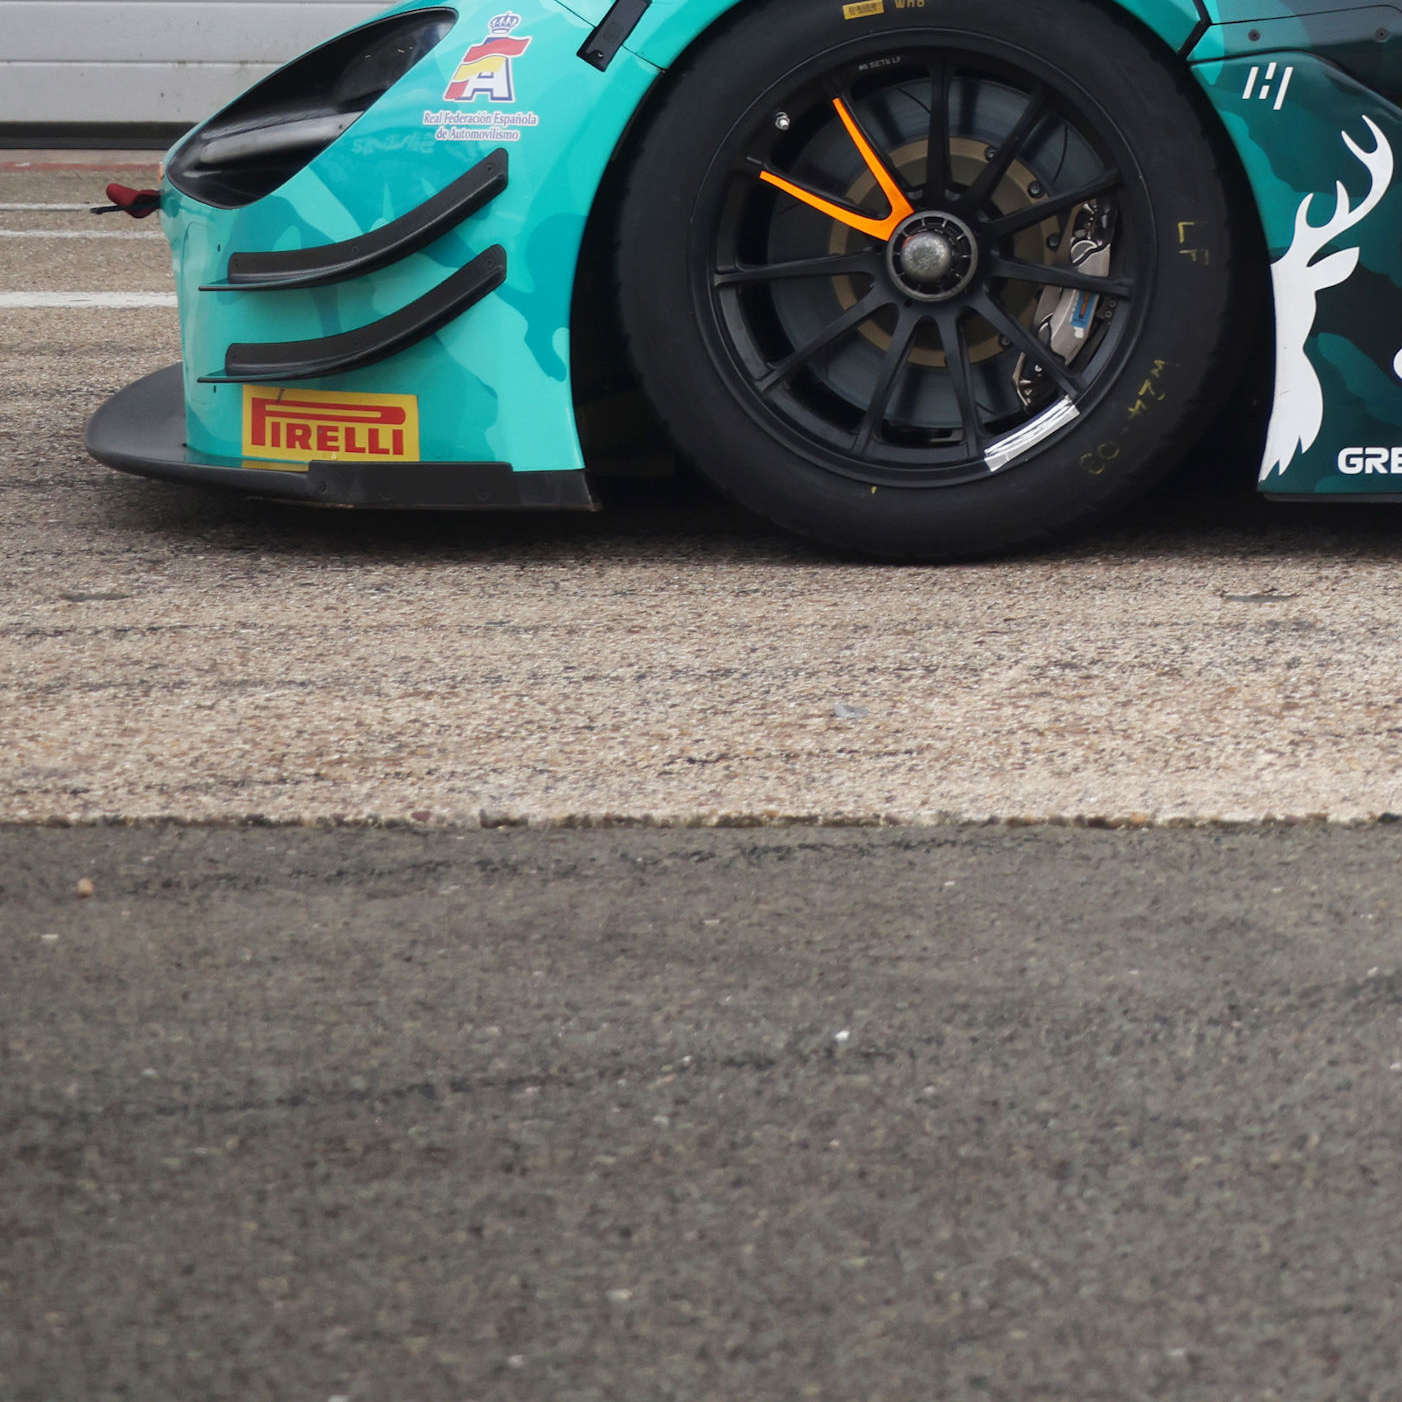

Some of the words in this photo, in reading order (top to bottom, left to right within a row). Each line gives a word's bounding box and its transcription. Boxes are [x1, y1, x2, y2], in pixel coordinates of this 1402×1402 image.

[424, 112, 441, 124] Real
[444, 112, 491, 124] Federación
[494, 113, 537, 127] Española
[436, 128, 446, 138] de
[450, 128, 519, 140] Automovilismo
[250, 396, 406, 456] PIRELLI
